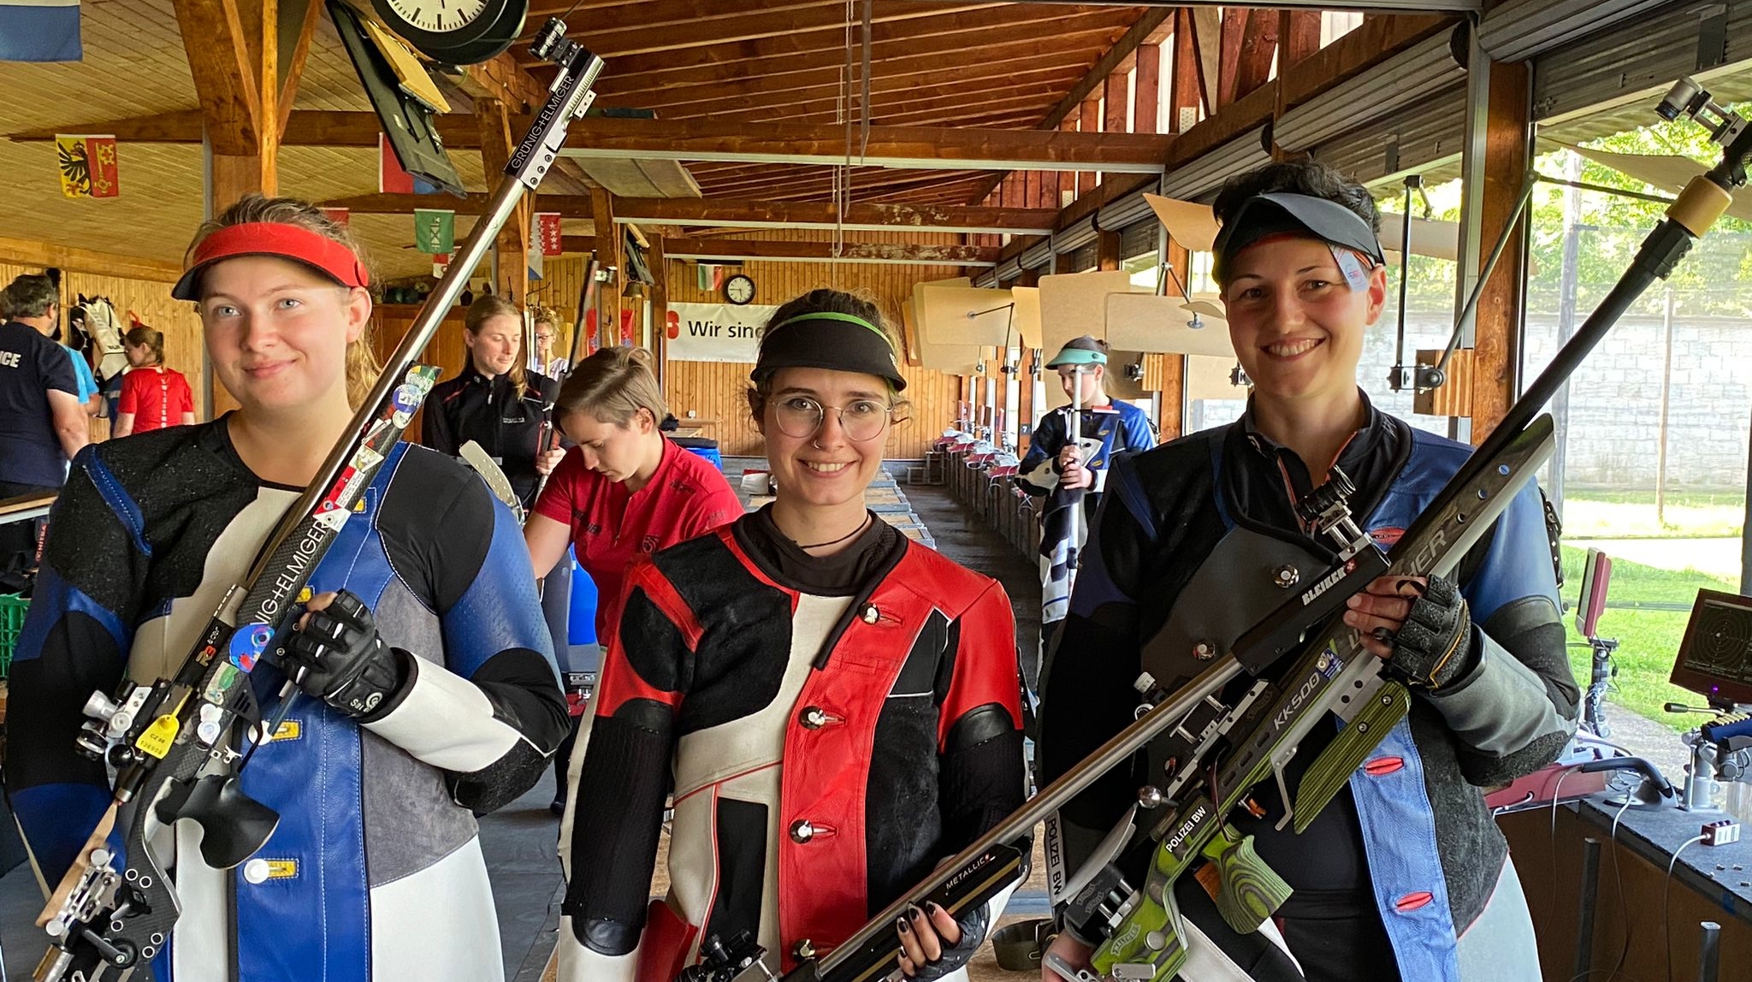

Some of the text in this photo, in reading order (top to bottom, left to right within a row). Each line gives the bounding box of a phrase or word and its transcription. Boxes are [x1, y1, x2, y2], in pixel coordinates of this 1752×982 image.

[510, 75, 575, 169] GRÜNIG+ELMIGER
[687, 320, 722, 337] Wir
[1022, 425, 1028, 433] 7
[1301, 565, 1347, 606] BLEIKER
[1273, 671, 1320, 731] KK500
[1165, 806, 1206, 853] POLIZEI BW
[945, 856, 985, 890] METALLIC
[1047, 817, 1062, 896] POLIZEI BW
